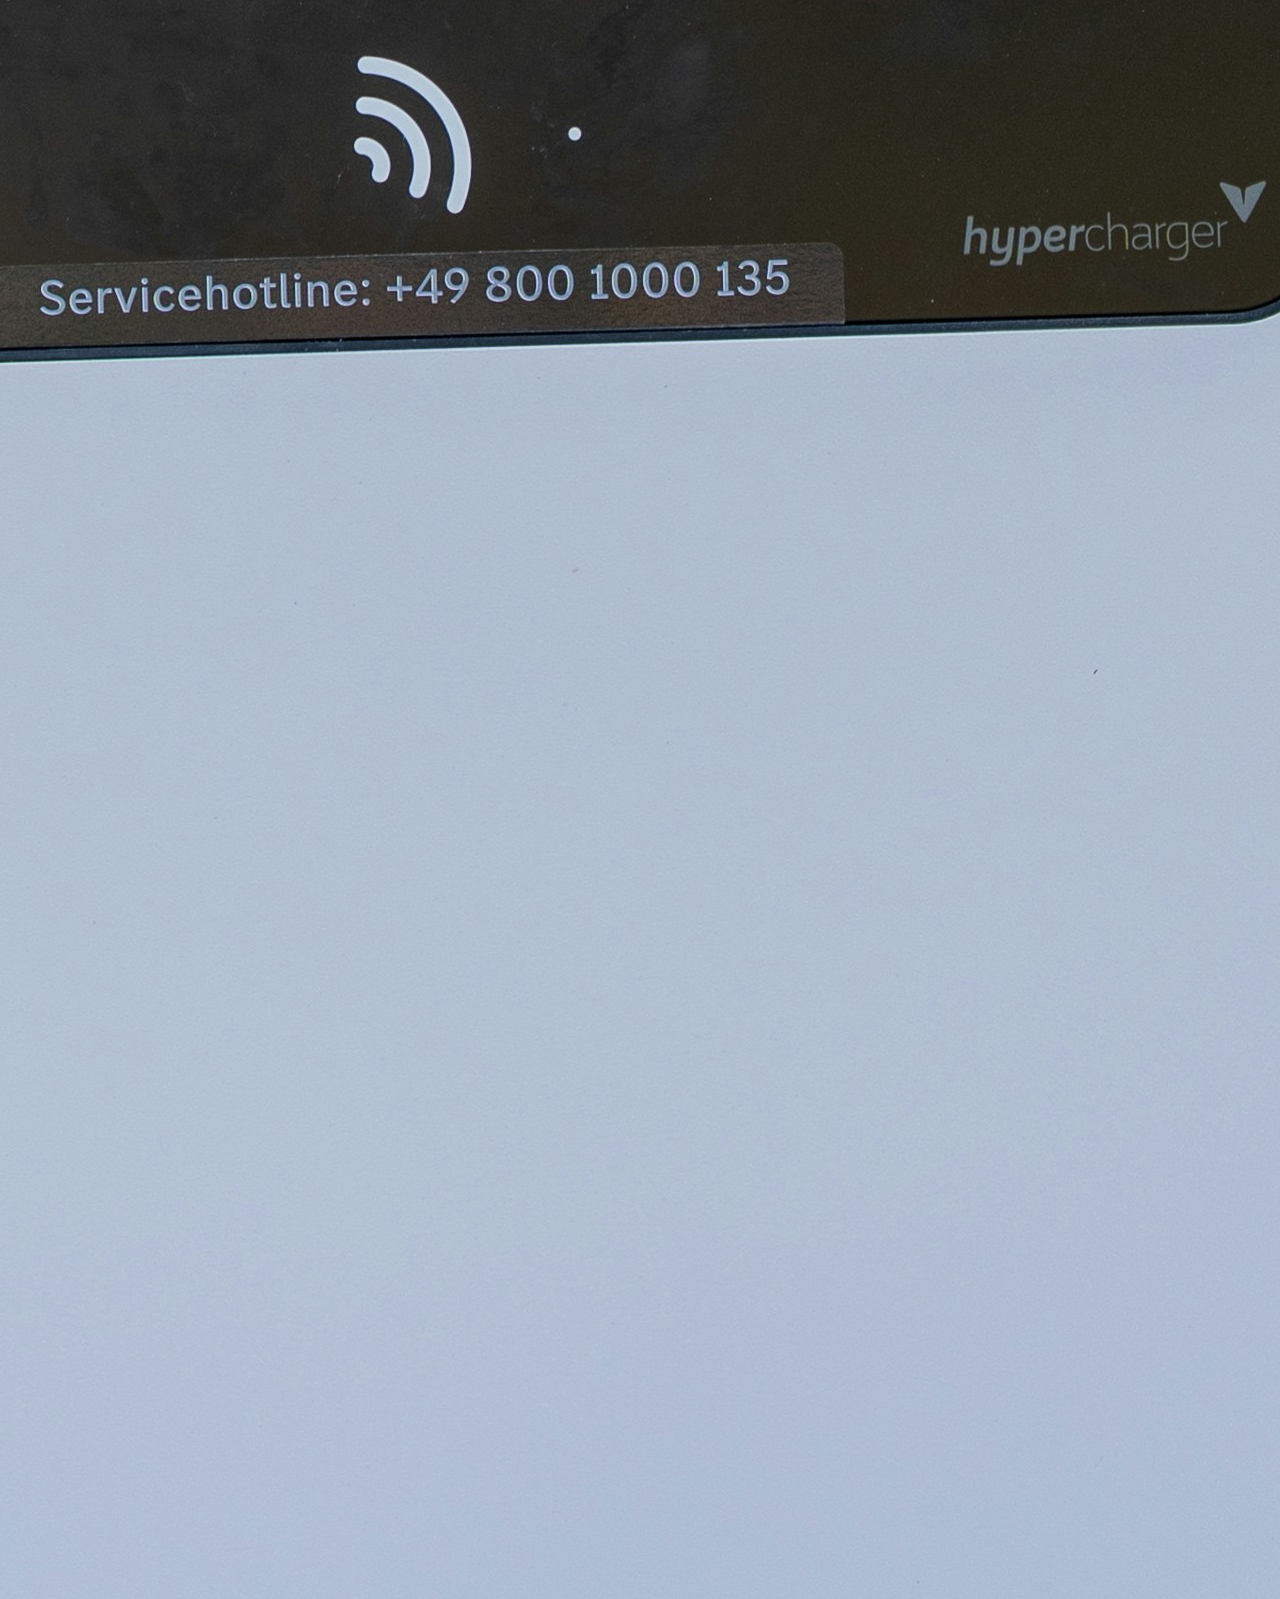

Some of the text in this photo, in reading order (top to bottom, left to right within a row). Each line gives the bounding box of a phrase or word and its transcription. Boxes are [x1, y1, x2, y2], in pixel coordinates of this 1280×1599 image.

[962, 210, 1229, 268] hypercharger
[40, 259, 790, 316] Servicehotline: +49 800 1000 135
